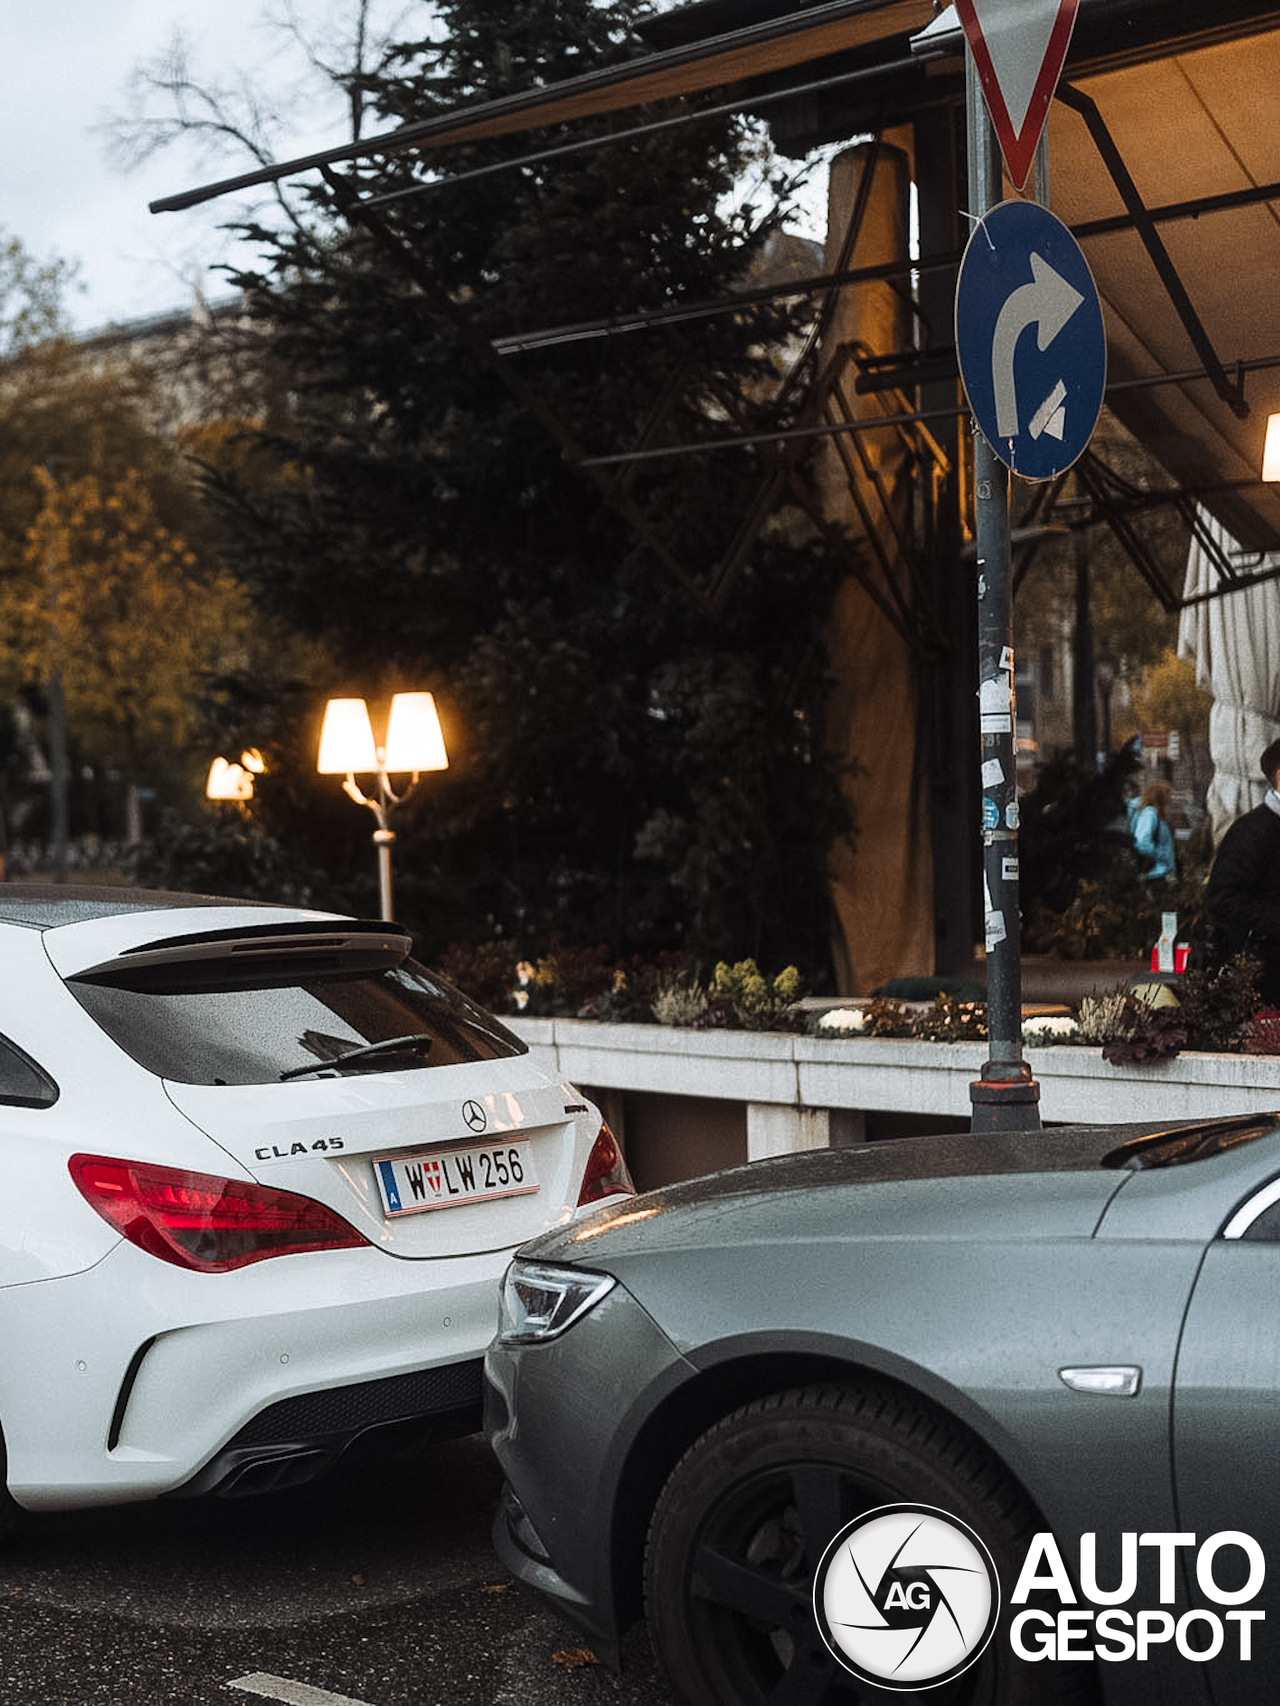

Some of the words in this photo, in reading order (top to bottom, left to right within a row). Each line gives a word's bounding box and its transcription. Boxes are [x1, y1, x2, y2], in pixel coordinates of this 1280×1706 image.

[255, 1142, 308, 1160] CLA
[311, 1137, 344, 1151] 45
[405, 1163, 426, 1200] W
[442, 1155, 476, 1194] LW
[479, 1149, 524, 1188] 256
[390, 1192, 398, 1204] A
